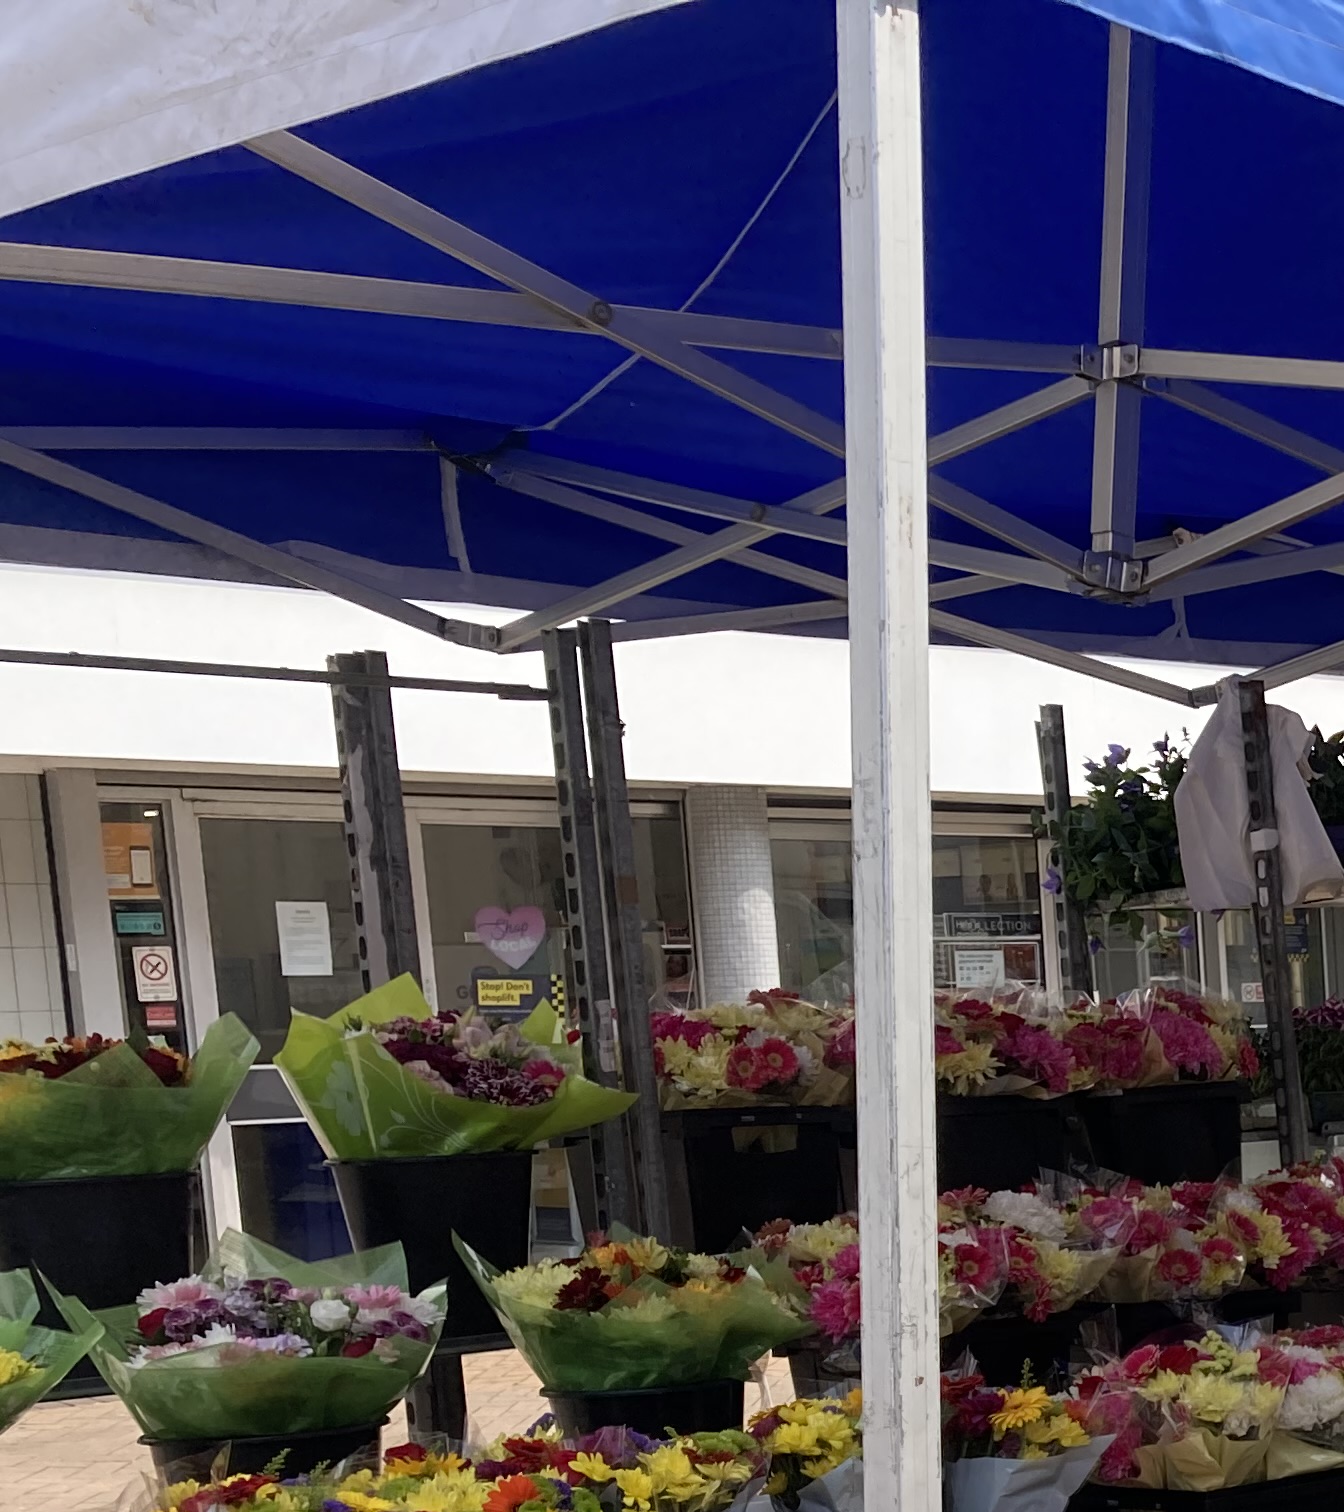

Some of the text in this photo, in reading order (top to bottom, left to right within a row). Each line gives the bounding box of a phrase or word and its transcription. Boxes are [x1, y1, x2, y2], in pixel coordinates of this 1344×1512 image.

[480, 981, 531, 991] Stop! Don't
[481, 993, 518, 1004] shoplift.
